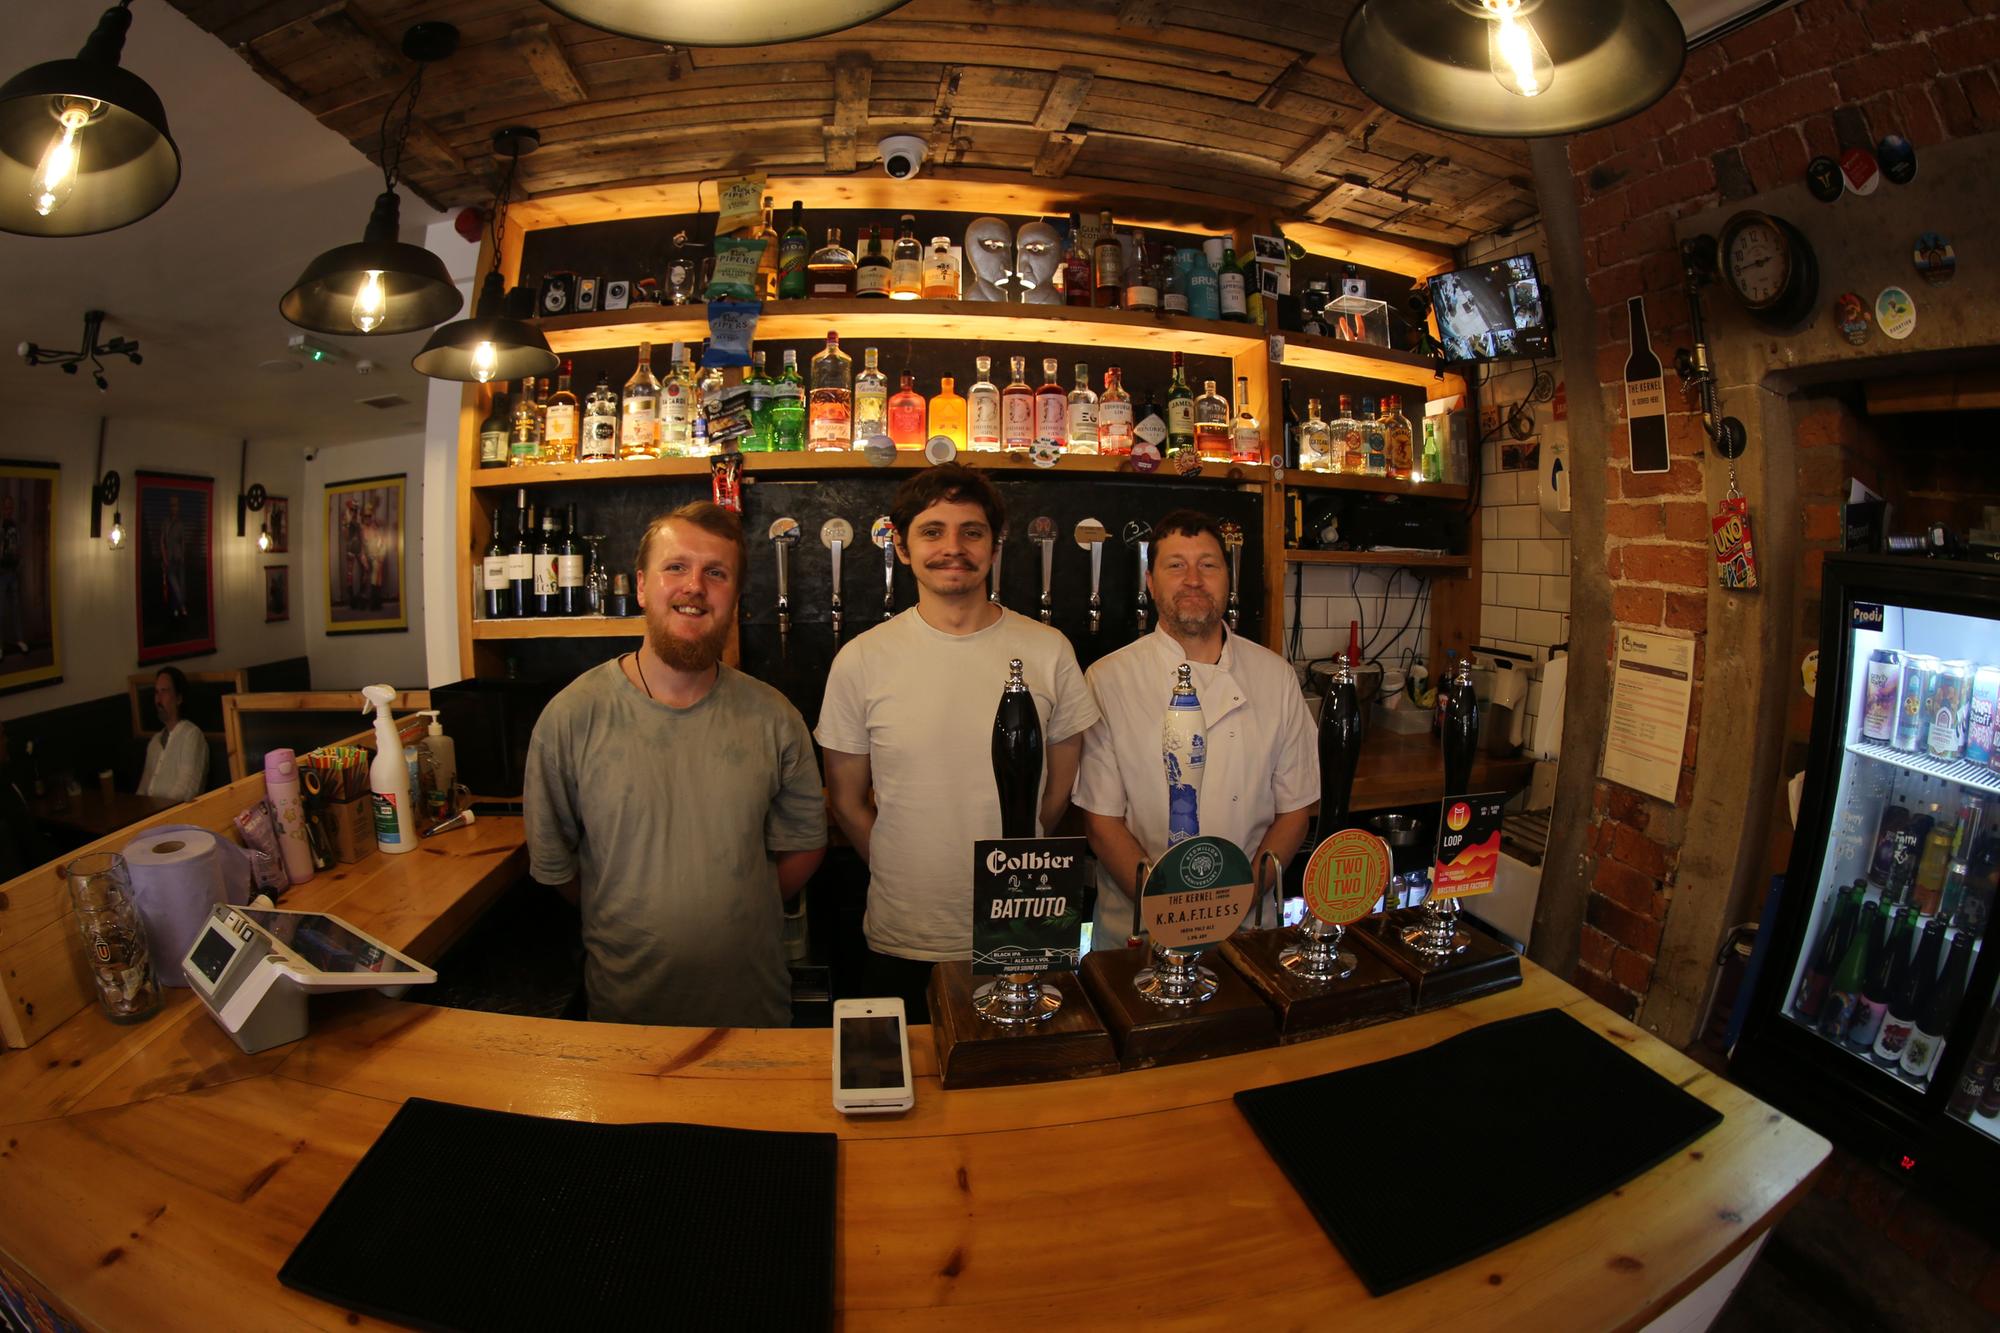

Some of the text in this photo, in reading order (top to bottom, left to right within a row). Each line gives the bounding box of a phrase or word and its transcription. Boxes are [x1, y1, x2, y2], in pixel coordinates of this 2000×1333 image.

[723, 187, 758, 199] PIPERS
[719, 255, 756, 266] PIPERS
[713, 319, 748, 329] PIPERS
[1628, 381, 1662, 394] THE KERNEL
[1714, 515, 1743, 554] UNO
[1854, 607, 1882, 623] Prodis
[1444, 835, 1463, 847] LOOP
[1895, 831, 1917, 847] FAITH
[986, 848, 1074, 876] Colbier
[1335, 858, 1363, 876] TWO
[1334, 877, 1361, 896] TWO
[1169, 892, 1213, 905] THE KERNEL
[990, 897, 1067, 919] BATTUTO
